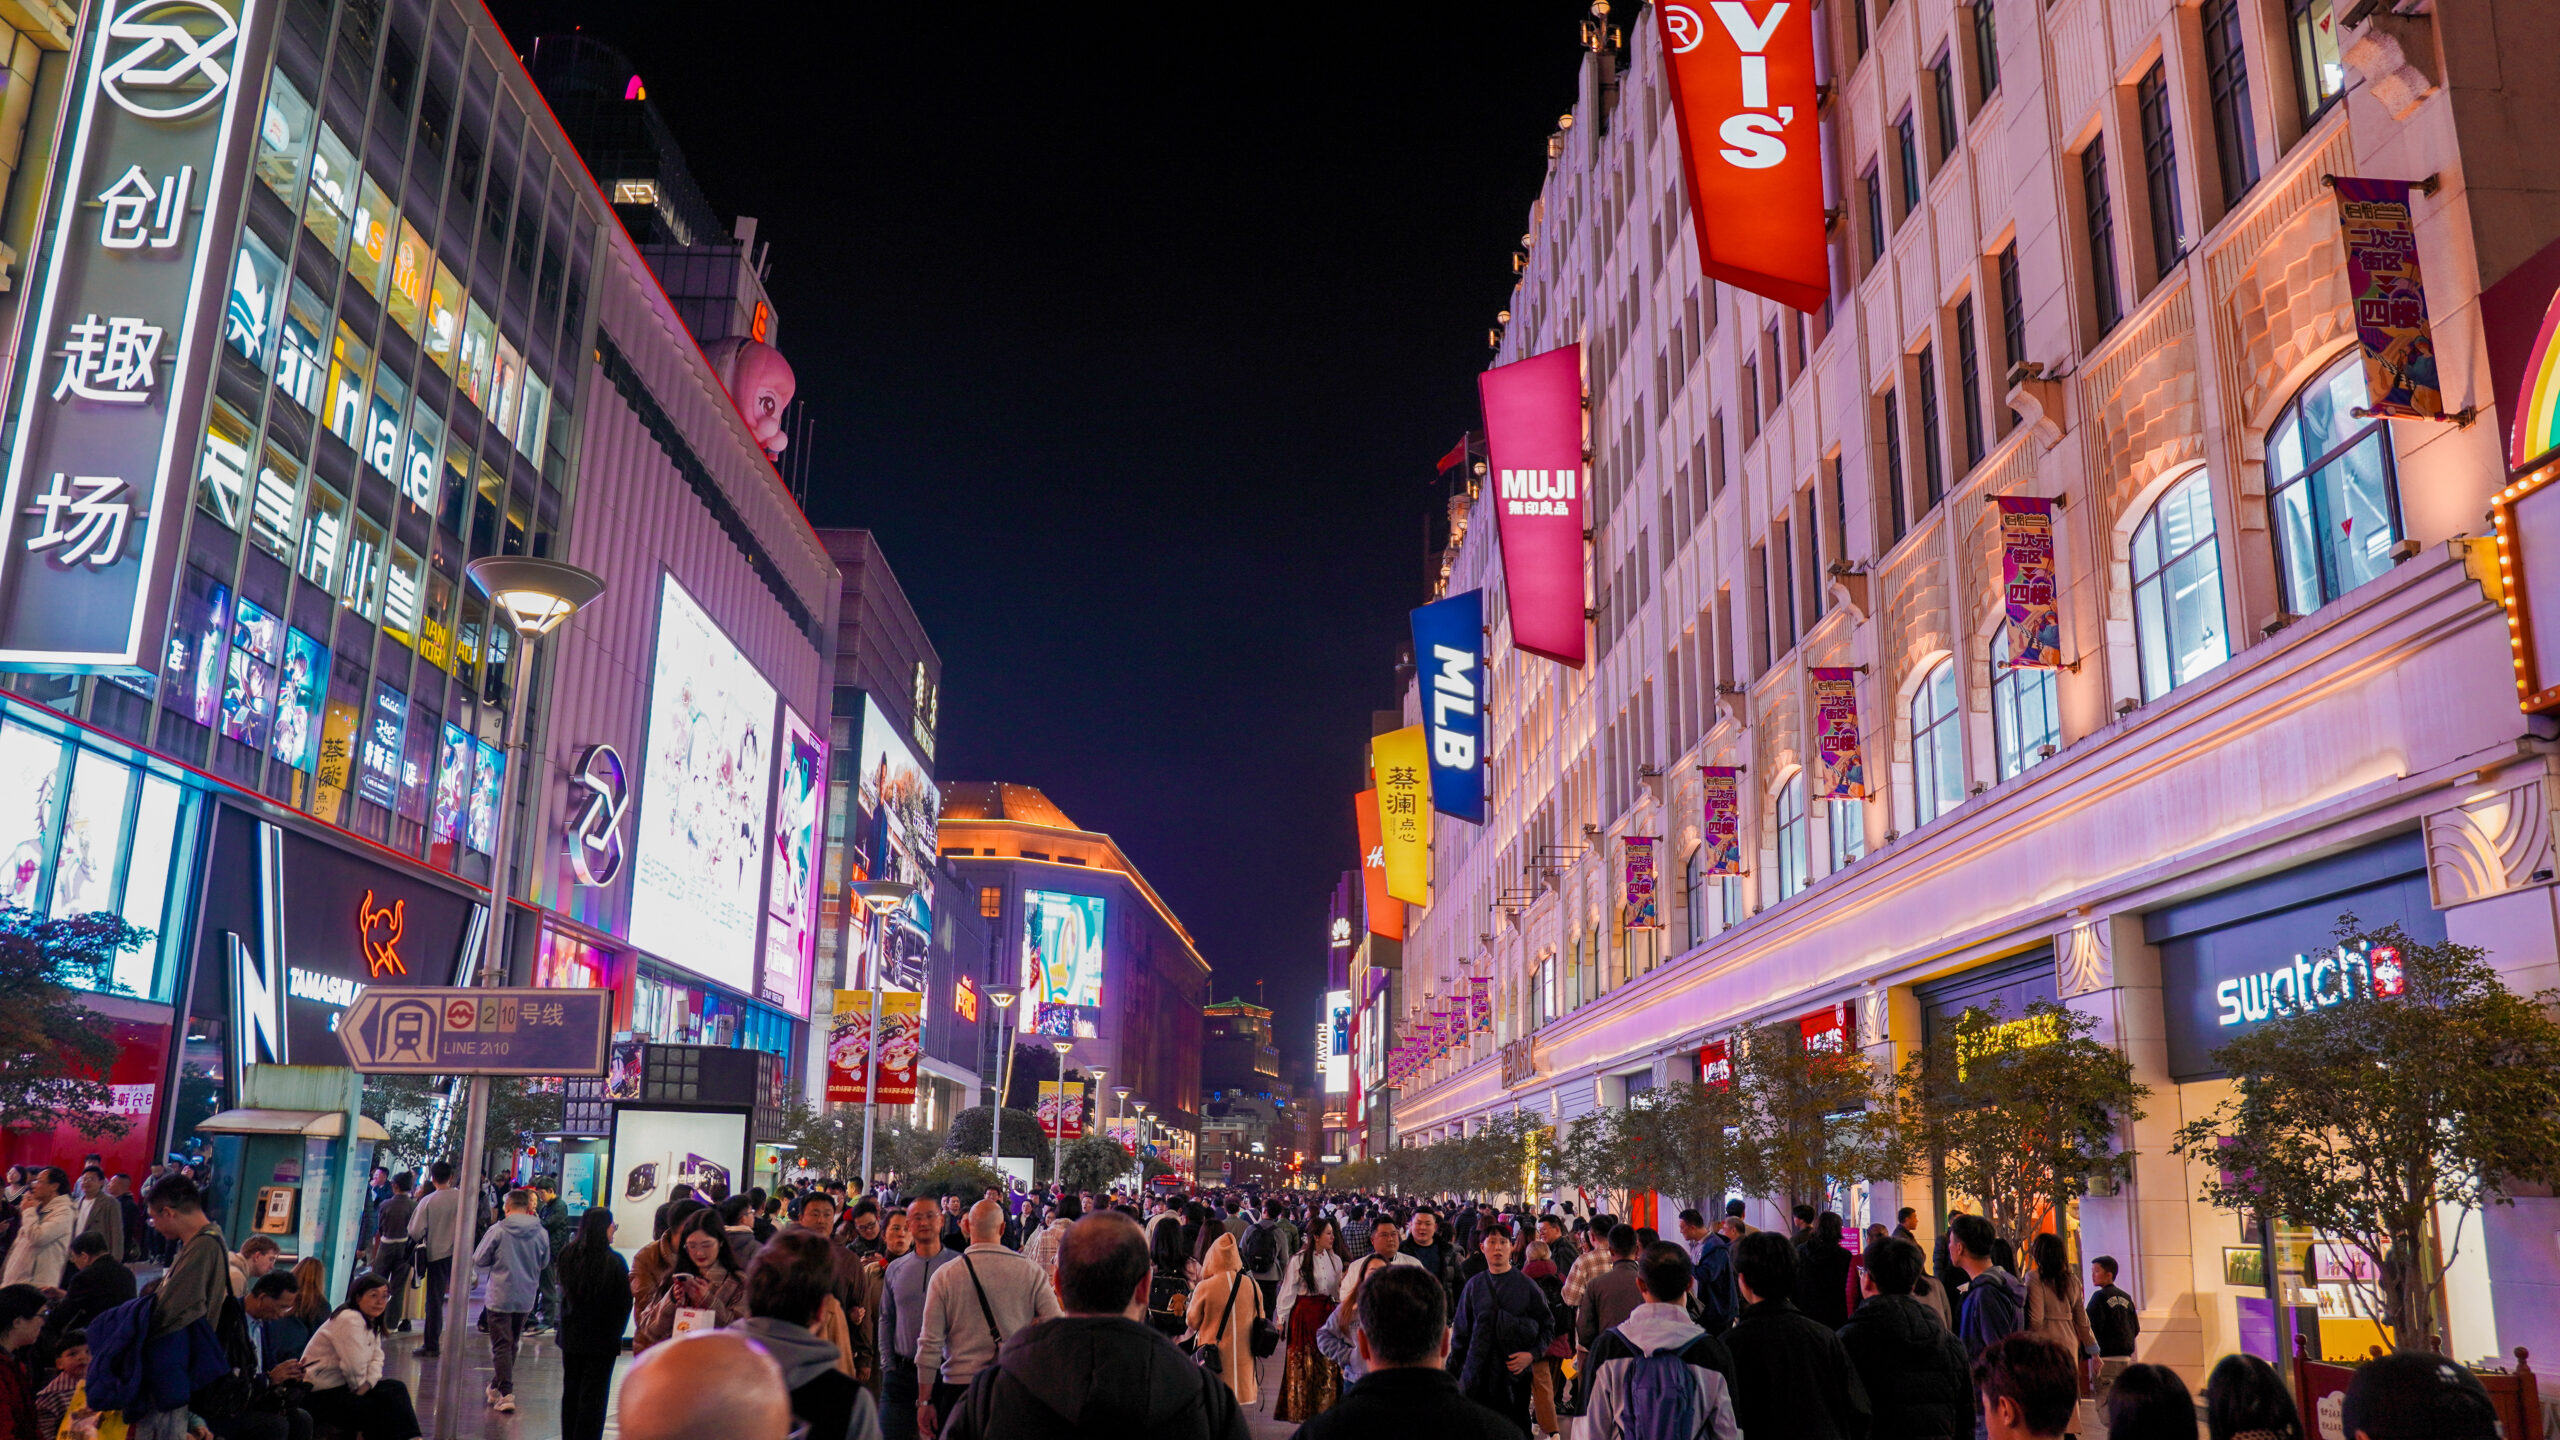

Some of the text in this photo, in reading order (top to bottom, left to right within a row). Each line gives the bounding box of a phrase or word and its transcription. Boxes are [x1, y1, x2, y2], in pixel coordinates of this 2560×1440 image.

[1502, 469, 1576, 499] MUJI
[1508, 500, 1569, 516] 無印良品
[1433, 643, 1475, 772] MLB
[2217, 945, 2372, 1026] swatch
[482, 1003, 564, 1026] 2 10 号线
[444, 1042, 476, 1055] LINE
[1317, 1023, 1327, 1073] HUAWEI
